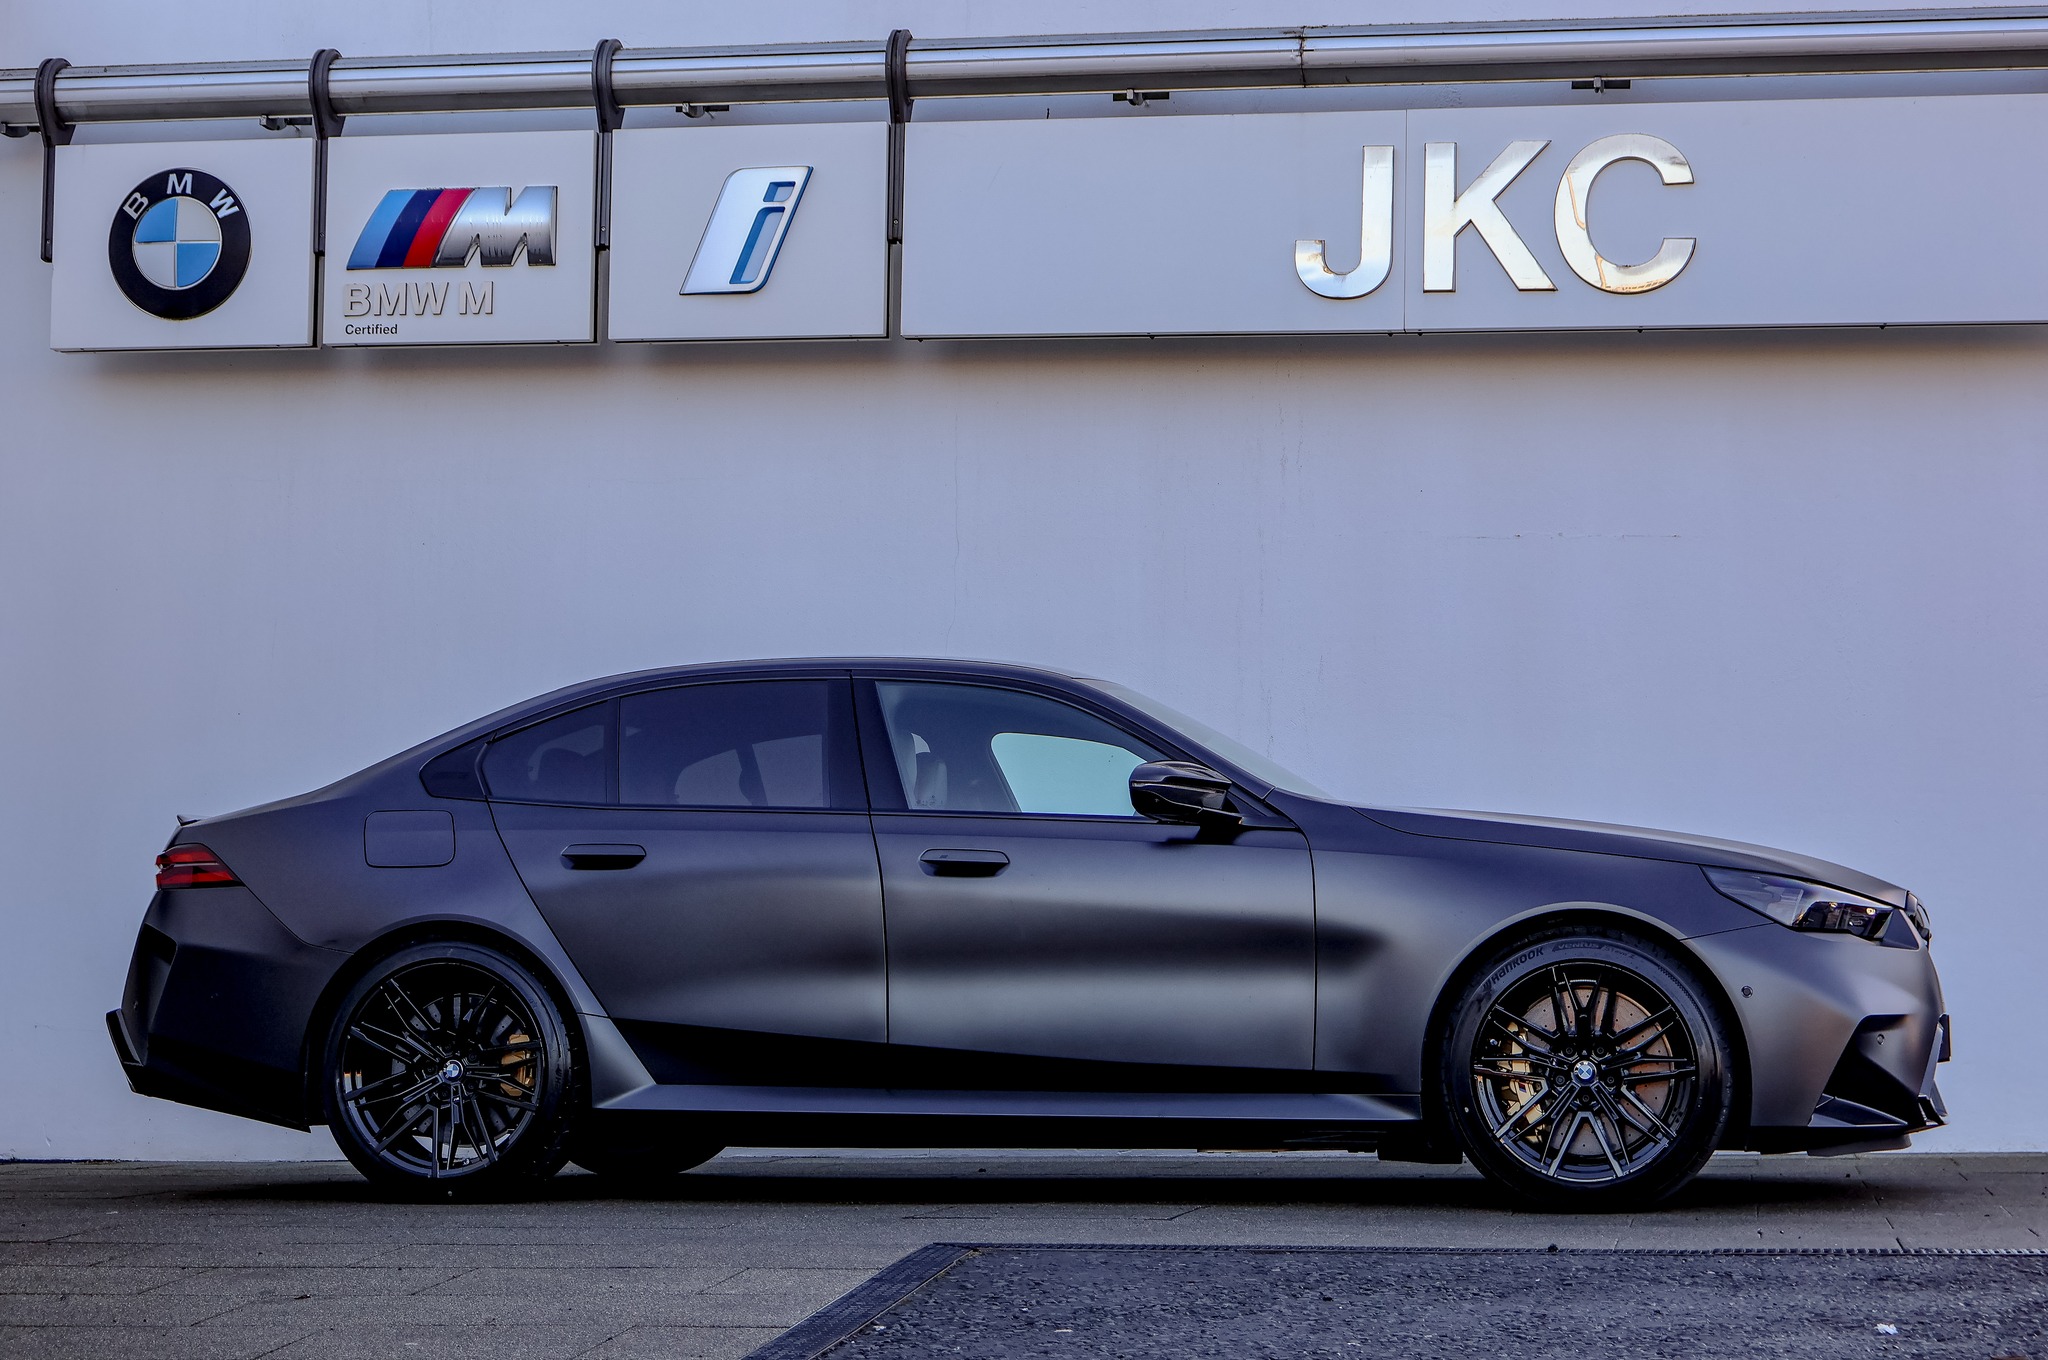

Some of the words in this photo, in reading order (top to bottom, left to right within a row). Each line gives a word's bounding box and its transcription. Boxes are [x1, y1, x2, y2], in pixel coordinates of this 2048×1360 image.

[122, 172, 240, 221] BMW
[1294, 132, 1697, 300] JKC
[433, 185, 558, 269] M
[344, 282, 450, 317] BMW
[459, 281, 494, 315] M
[345, 323, 398, 335] Certified
